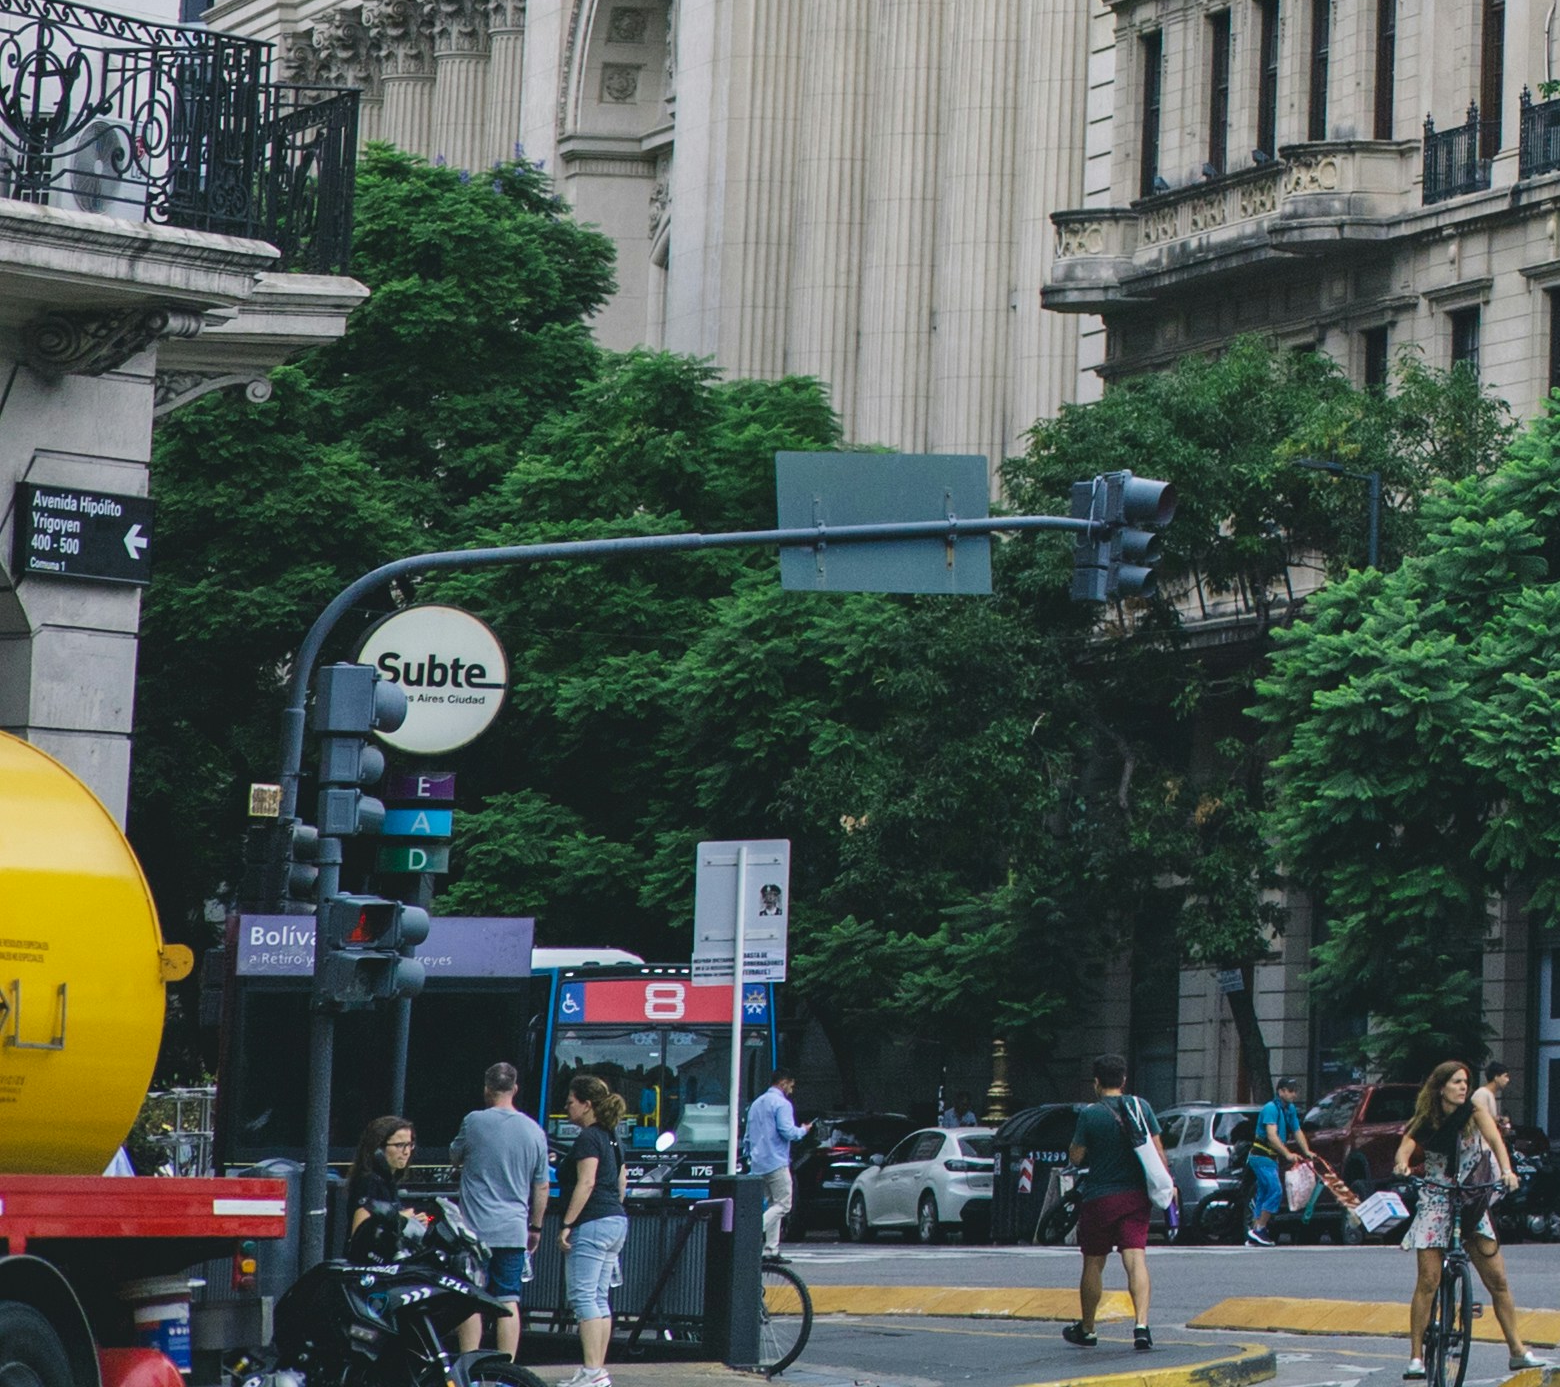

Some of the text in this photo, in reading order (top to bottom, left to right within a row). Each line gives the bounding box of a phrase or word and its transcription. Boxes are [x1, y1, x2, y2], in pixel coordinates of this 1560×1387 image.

[33, 490, 122, 517] Avenida Hipólito
[32, 511, 80, 534] Yrigoyen
[31, 534, 51, 551] 400
[60, 537, 79, 555] 500
[61, 561, 66, 571] 1
[378, 652, 504, 690] Subte
[417, 694, 444, 704] Aires
[447, 694, 486, 704] Ciudad
[417, 776, 430, 796] E
[410, 811, 430, 833] A
[408, 848, 427, 870] D
[250, 955, 257, 965] a
[261, 952, 302, 965] Retiro
[644, 983, 685, 1019] 8
[691, 1166, 713, 1177] 1176
